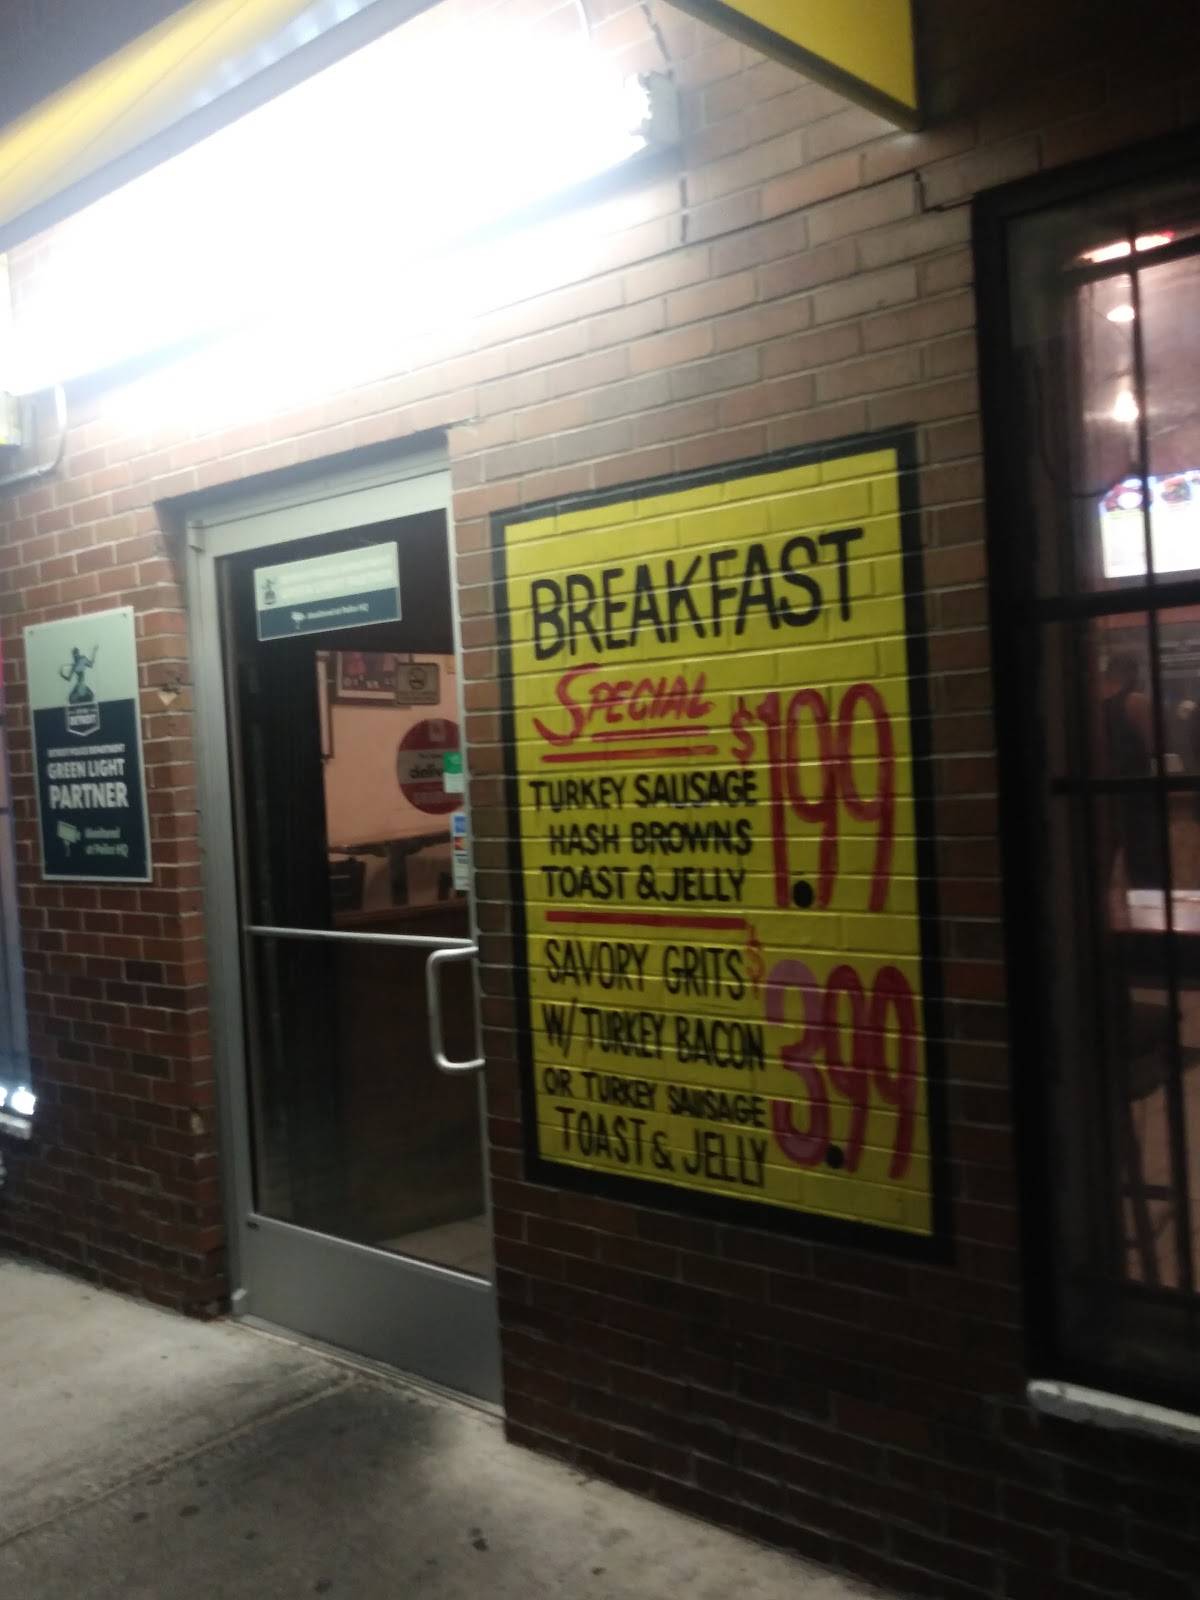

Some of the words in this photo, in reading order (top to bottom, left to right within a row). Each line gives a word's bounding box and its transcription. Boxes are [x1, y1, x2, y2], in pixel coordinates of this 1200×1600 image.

[530, 527, 864, 661] BREAKFAST
[47, 760, 87, 780] GREEN
[87, 758, 126, 777] LIGHT
[529, 776, 627, 812] TURKEY
[633, 771, 758, 808] SAUSAGE
[48, 781, 130, 809] PARTNER
[549, 823, 621, 856] HASH
[630, 819, 753, 856] BROWNS
[540, 865, 629, 901] TOAST
[661, 867, 747, 902] JELLY
[545, 939, 649, 993] SAVORY
[662, 944, 746, 1001] GRITS
[675, 1015, 766, 1072] BACON
[544, 1067, 574, 1096] OR
[582, 1071, 657, 1113] TURKEY
[667, 1084, 767, 1128] SAUSAGE
[555, 1105, 647, 1166] TOAST
[682, 1131, 768, 1188] JELLY
